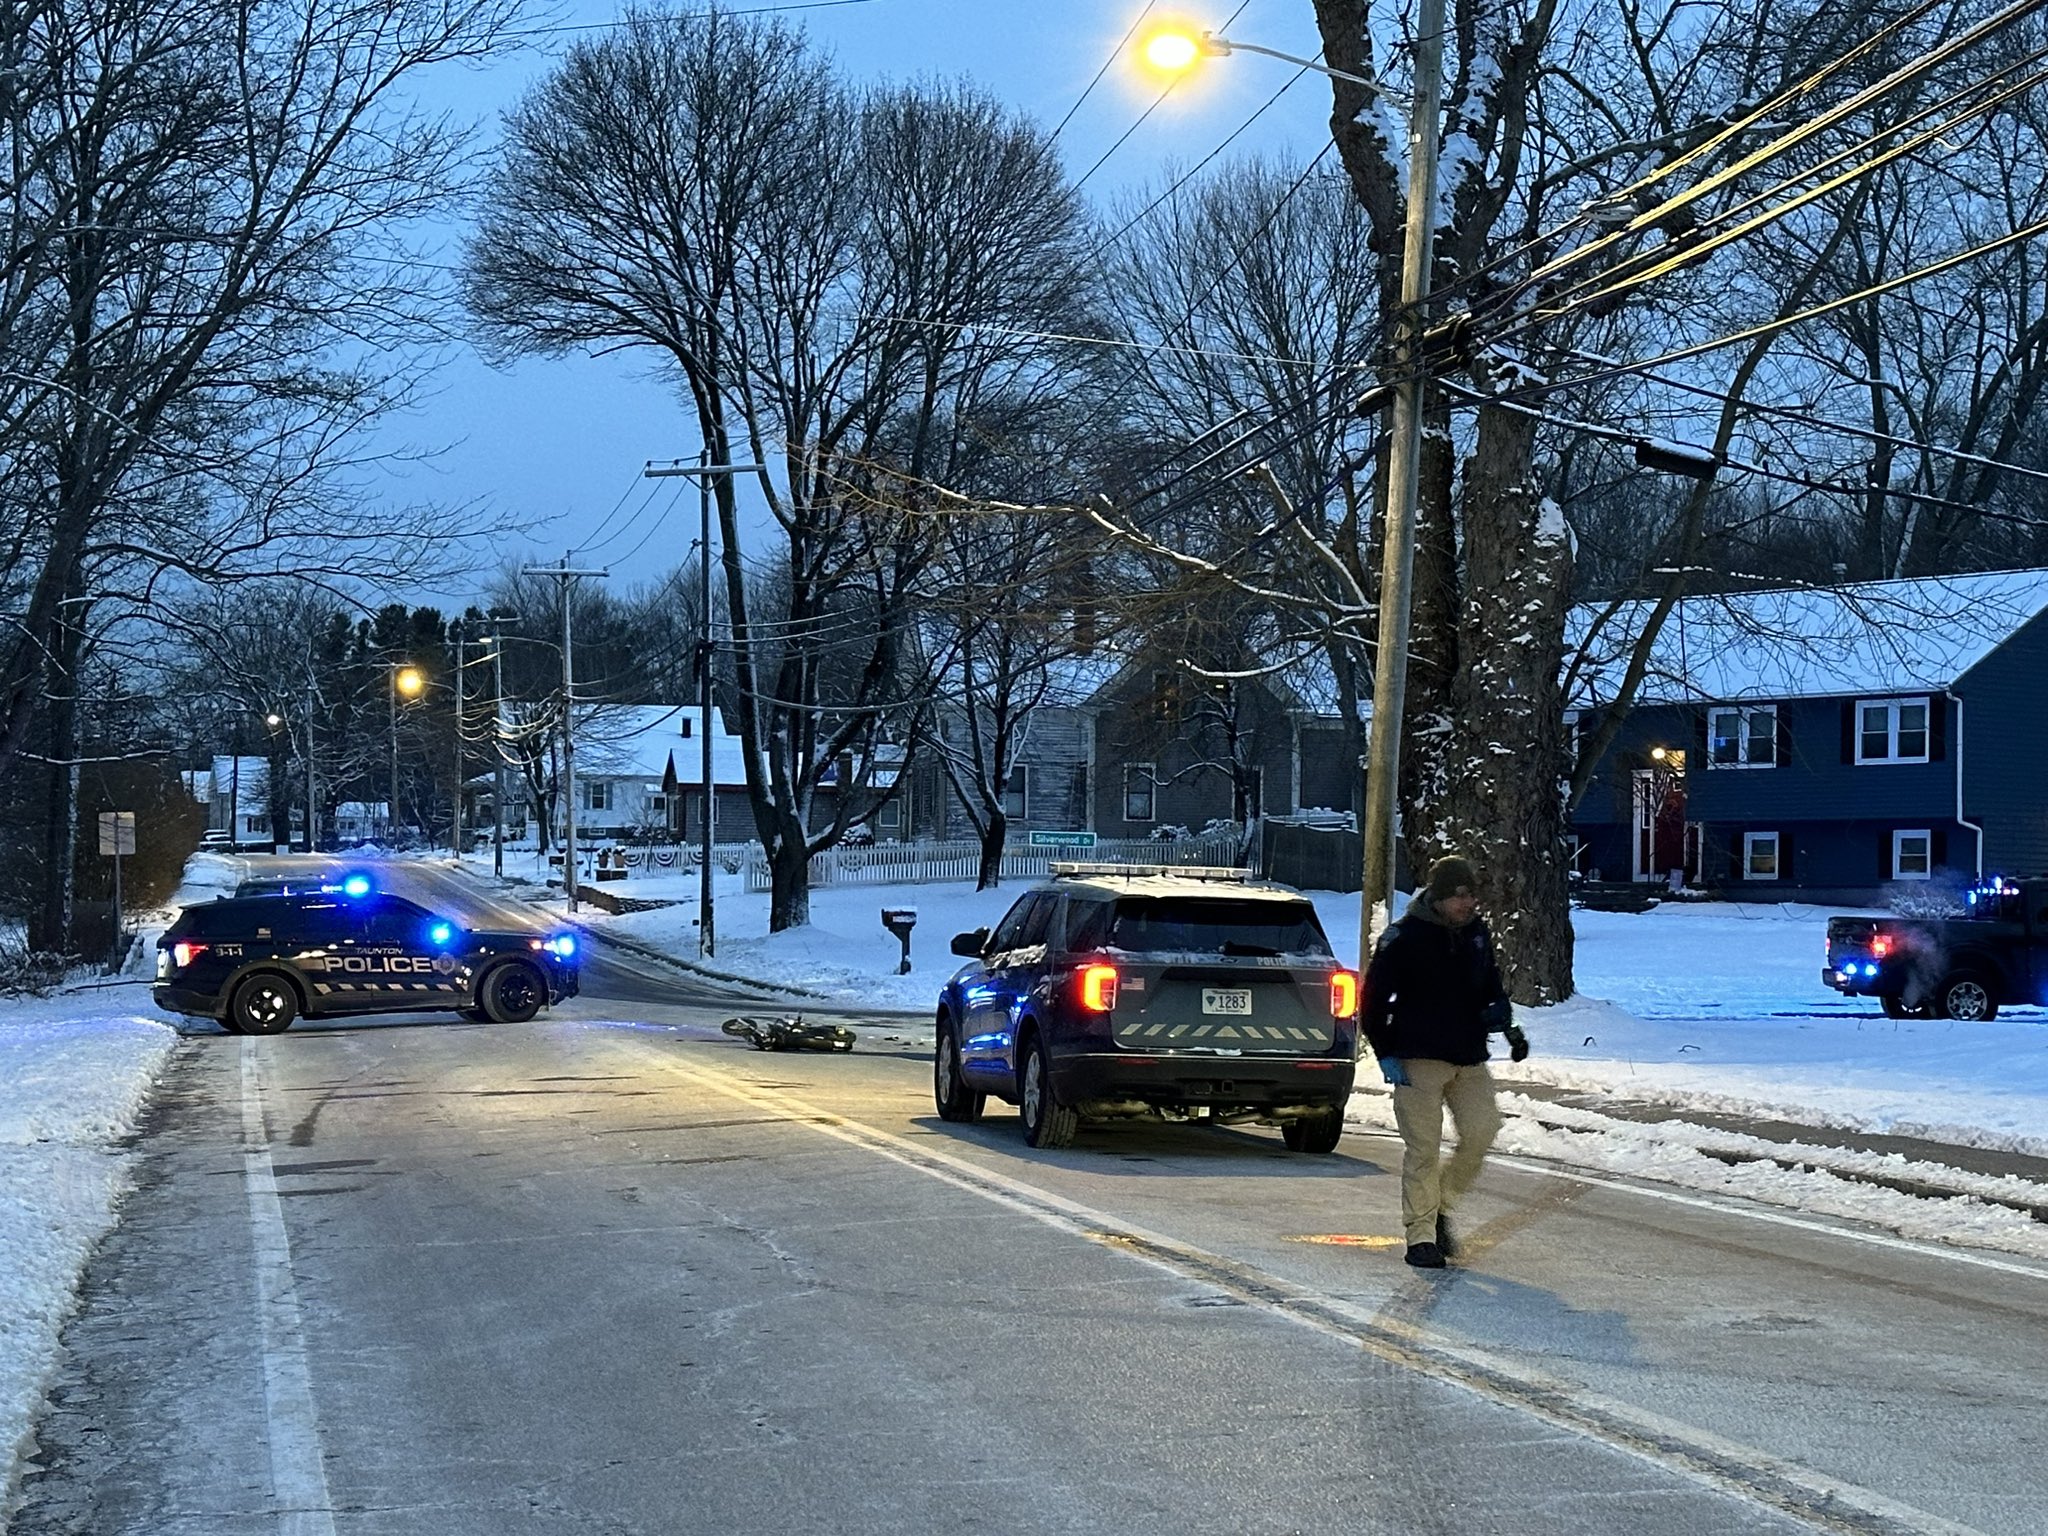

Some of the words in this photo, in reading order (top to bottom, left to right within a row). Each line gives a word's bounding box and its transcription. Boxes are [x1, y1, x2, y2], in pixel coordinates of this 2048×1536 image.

[1035, 834, 1079, 844] Silverwood
[215, 948, 243, 957] 9-1-1
[355, 947, 403, 955] TAUNTON
[323, 957, 432, 973] POLICE
[1218, 995, 1246, 1008] 1283
